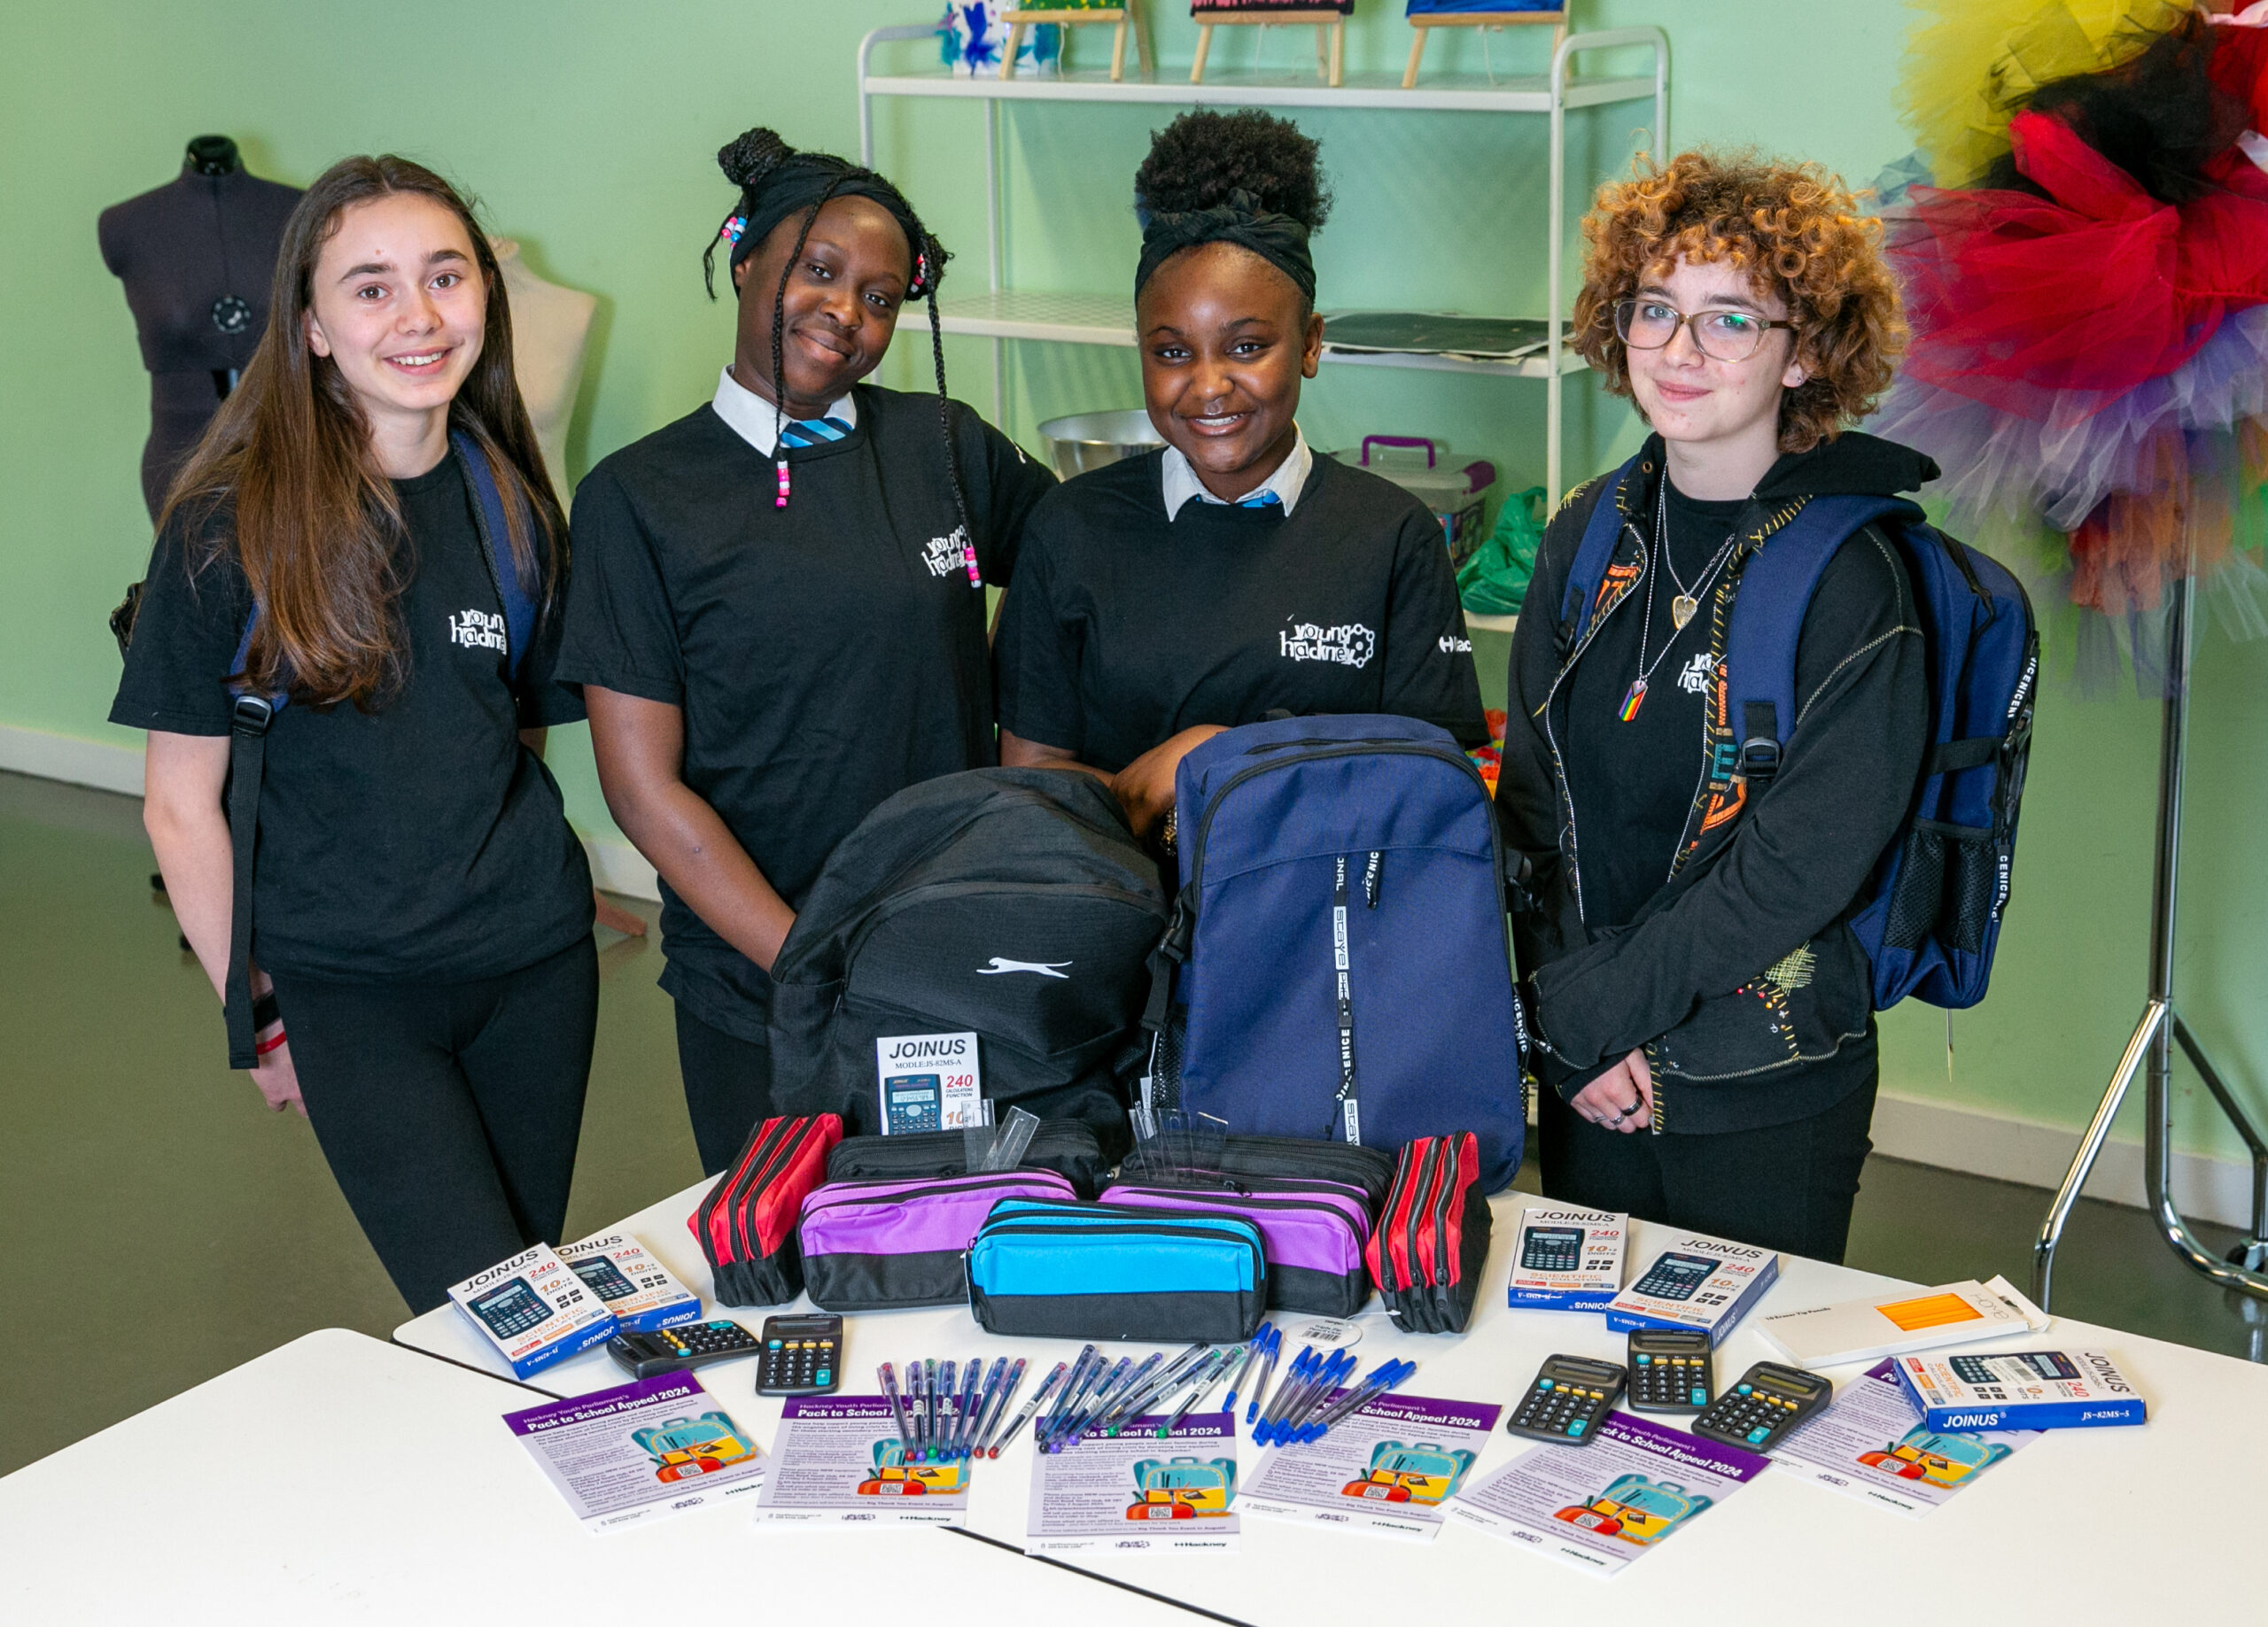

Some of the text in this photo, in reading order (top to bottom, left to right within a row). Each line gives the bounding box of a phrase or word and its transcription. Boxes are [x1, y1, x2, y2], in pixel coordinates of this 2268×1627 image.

[1290, 623, 1353, 644] young
[1279, 631, 1356, 666] hackney
[889, 1039, 967, 1059] JOINUS
[945, 1074, 974, 1089] 240
[1535, 1212, 1617, 1222] JOINUS
[557, 1236, 623, 1256] OINUS
[613, 1248, 641, 1259] 240
[1681, 1240, 1764, 1259] JOINUS
[463, 1250, 539, 1292] JOINUS
[529, 1261, 556, 1278] 240
[625, 1263, 645, 1274] 10
[1725, 1263, 1756, 1274] 240
[540, 1280, 561, 1293] 10
[547, 1281, 573, 1296] DIGITS
[1710, 1277, 1733, 1287] 10
[609, 1289, 668, 1308] CIENTIFIC
[1636, 1297, 1706, 1313] SCIENTIFIC
[517, 1306, 584, 1343] SCIENTIFIC
[662, 1311, 696, 1326] JOINUS
[1717, 1313, 1737, 1341] JOINUS
[582, 1326, 615, 1348] JOINUS
[1935, 1362, 1964, 1398] SCIENTIFIC
[2085, 1352, 2131, 1393] JOINUS
[2067, 1381, 2090, 1398] 240
[523, 1413, 557, 1424] Hackney
[557, 1406, 581, 1415] Youth
[527, 1419, 561, 1431] Pack
[574, 1404, 617, 1421] School
[617, 1394, 659, 1410] Appeal
[658, 1386, 691, 1400] 2024
[845, 1408, 888, 1417] School
[1361, 1406, 1481, 1428] School Appeal 2024
[1943, 1414, 1999, 1428] JOINUS
[1190, 1427, 1222, 1436] 2024
[1618, 1430, 1631, 1441] to
[1631, 1436, 1672, 1453] School
[1668, 1450, 1712, 1467] Appeal
[1709, 1461, 1744, 1477] 2024
